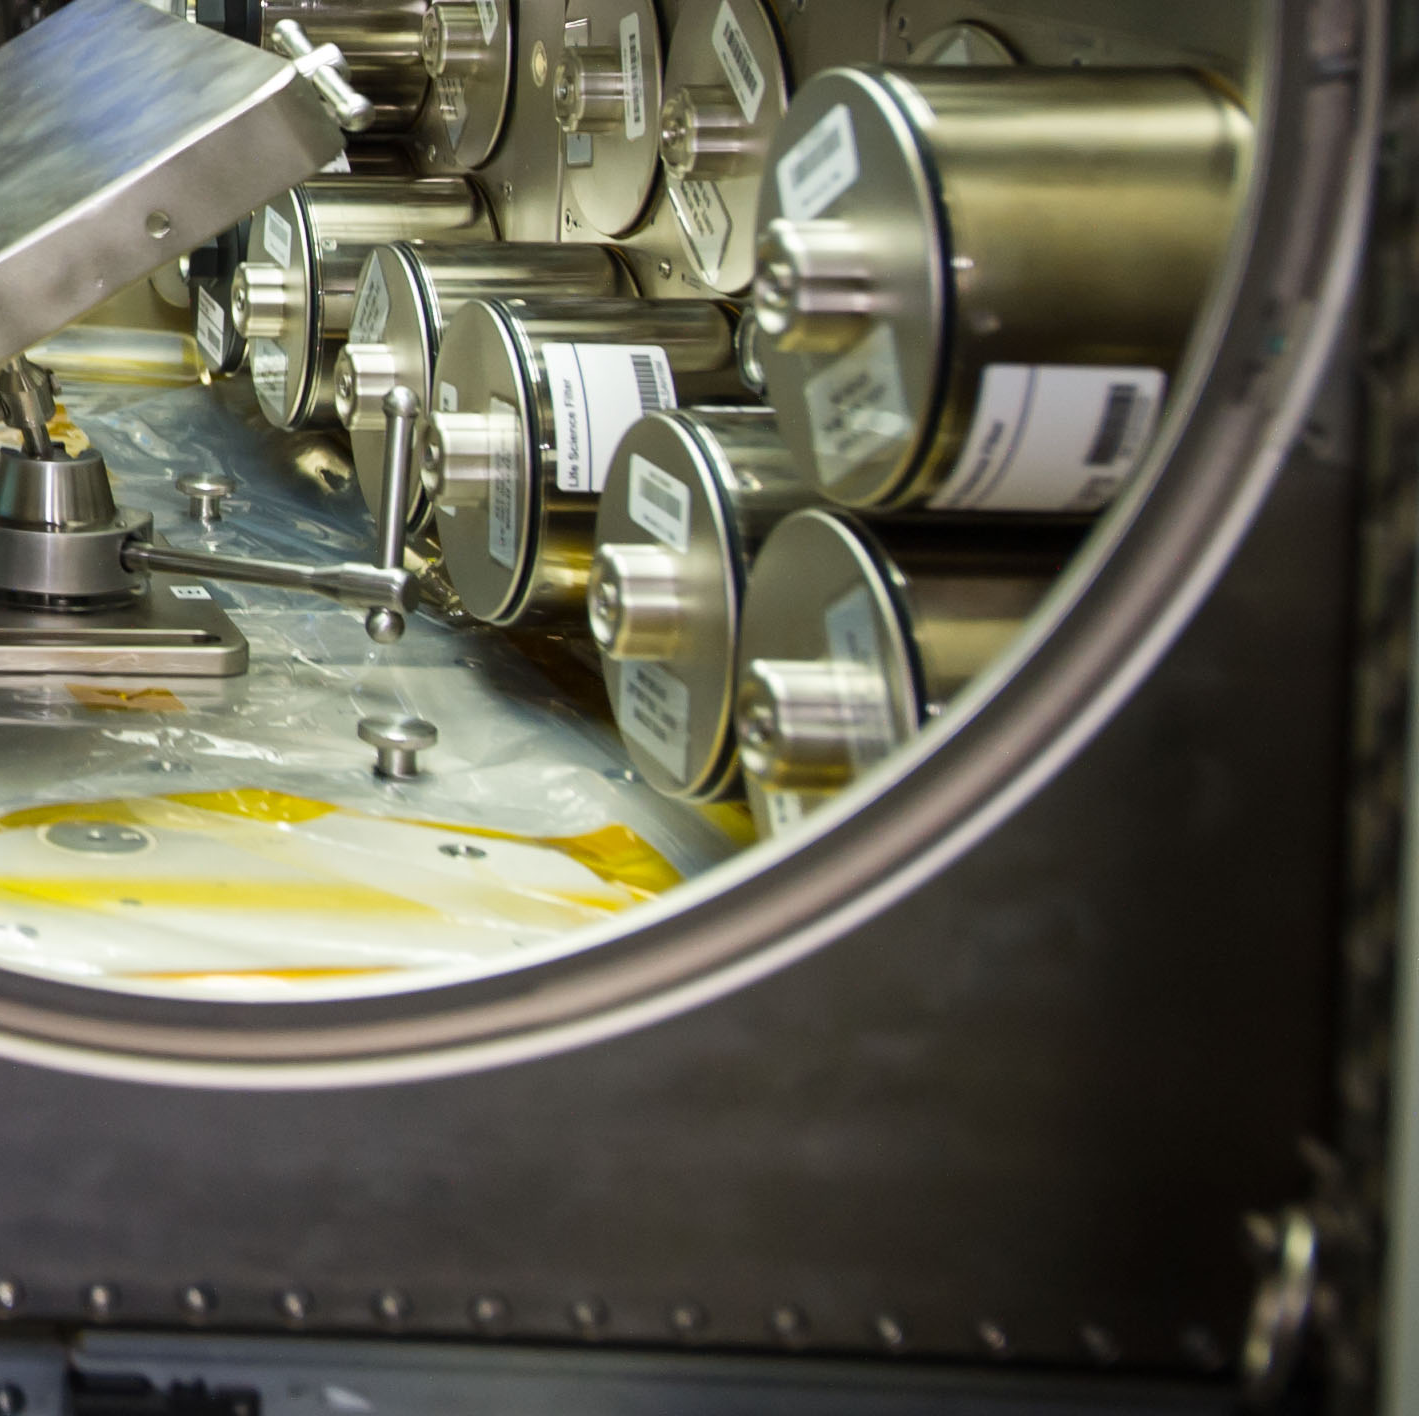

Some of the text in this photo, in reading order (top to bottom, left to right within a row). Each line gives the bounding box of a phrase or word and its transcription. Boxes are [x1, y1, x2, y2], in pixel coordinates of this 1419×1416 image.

[563, 379, 580, 488] Life Science Filter
